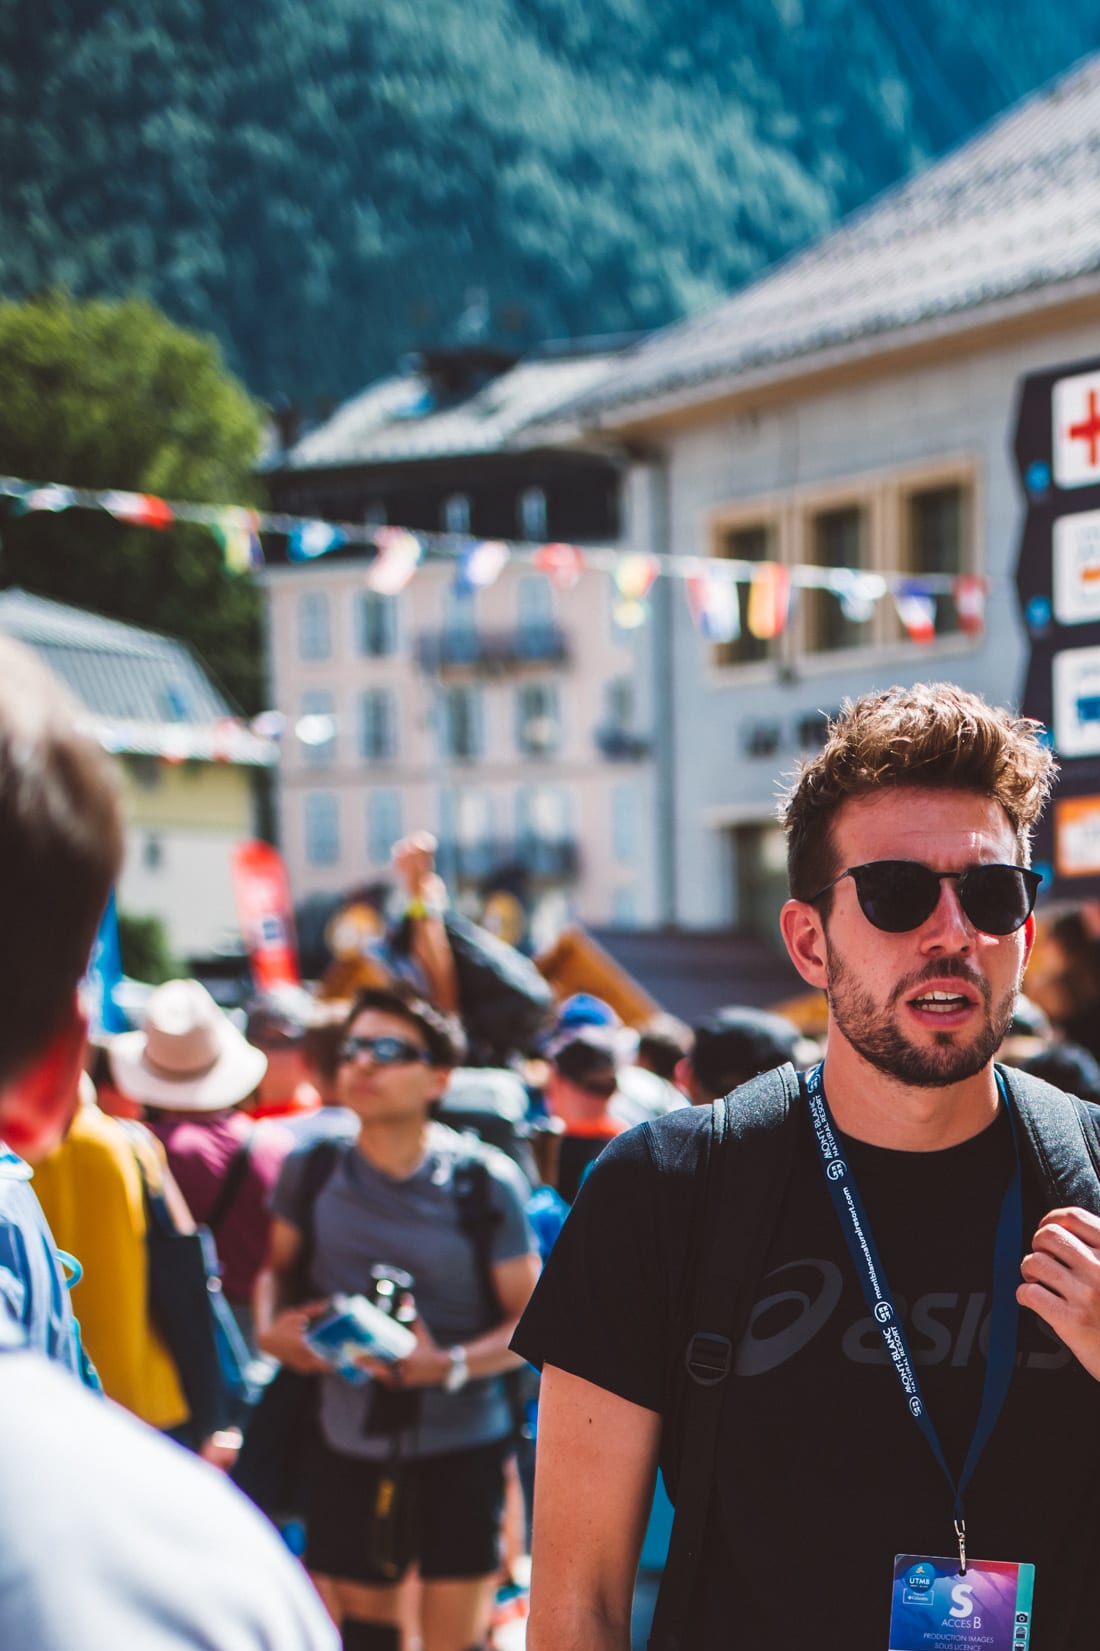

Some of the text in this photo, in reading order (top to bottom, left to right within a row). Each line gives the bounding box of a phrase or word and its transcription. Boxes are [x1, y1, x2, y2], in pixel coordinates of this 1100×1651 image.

[842, 1186, 882, 1300] montblancnaturalresort.com
[909, 1577, 930, 1585] UTMB
[948, 1583, 974, 1618] S
[941, 1616, 982, 1629] ACCES B
[923, 1632, 995, 1644] PRODUCTION IMAGES
[934, 1642, 982, 1651] SOUS LICENCE
